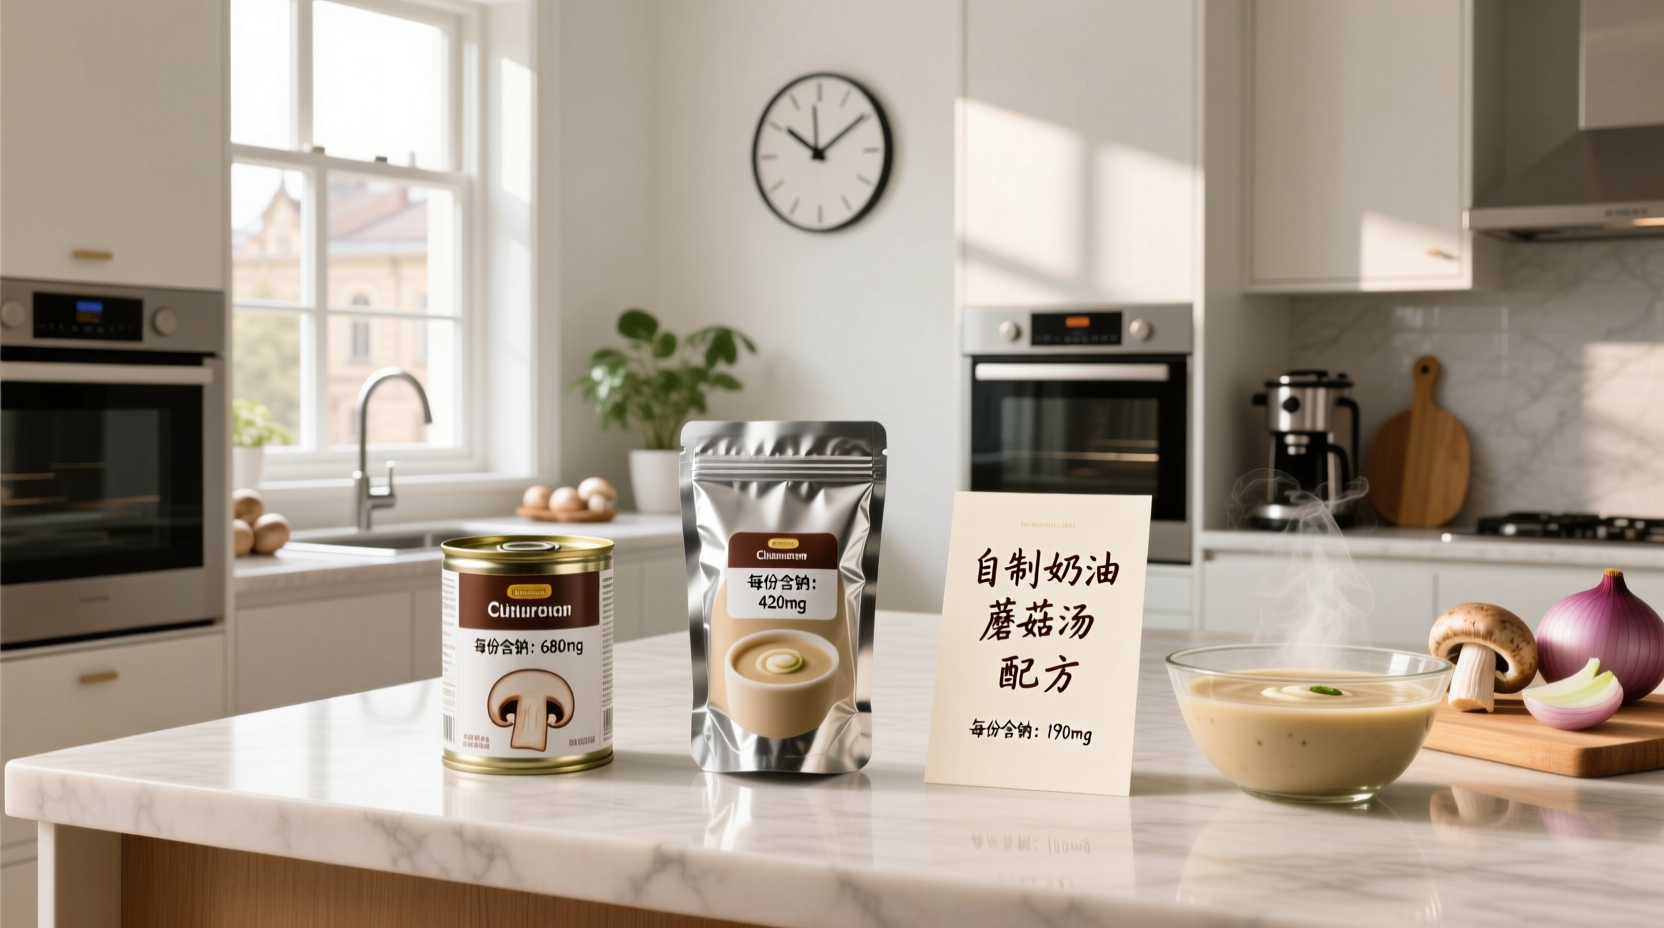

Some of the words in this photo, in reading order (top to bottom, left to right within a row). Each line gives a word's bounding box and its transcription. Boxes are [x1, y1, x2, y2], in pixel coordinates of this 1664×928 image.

[977, 547, 1120, 589] 自制奶油
[758, 594, 807, 614] 420mg
[979, 597, 1095, 641] 蘑菇汤
[999, 655, 1080, 693] 配方
[1047, 723, 1093, 746] 190mg
